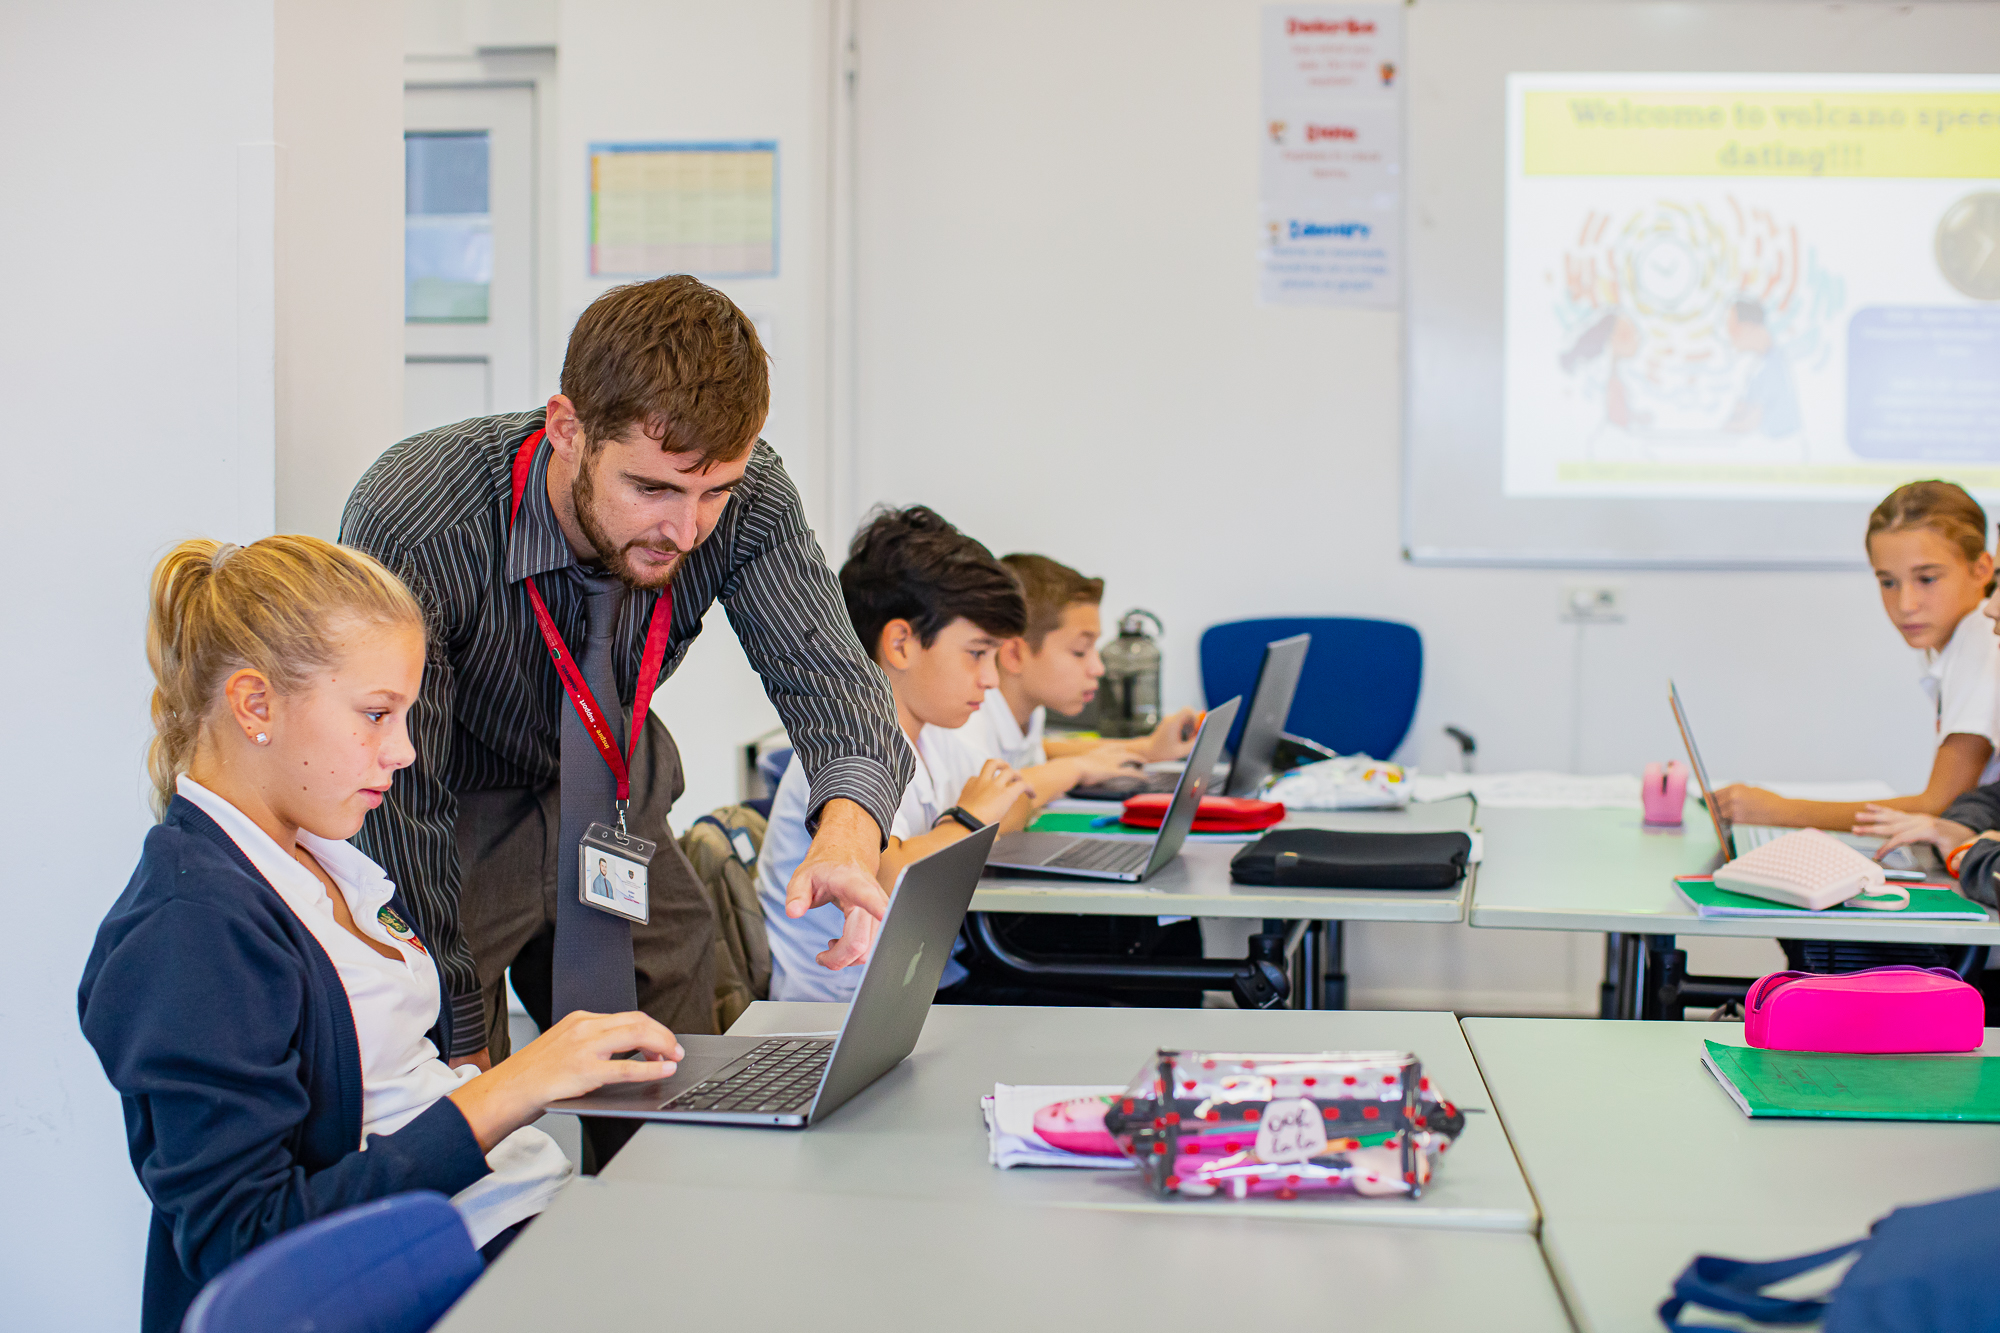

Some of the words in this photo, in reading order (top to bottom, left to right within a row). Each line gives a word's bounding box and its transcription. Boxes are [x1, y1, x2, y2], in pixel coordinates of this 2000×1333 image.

[1570, 98, 1725, 127] Welcome
[1734, 103, 1766, 126] to
[1774, 101, 1907, 127] volcano
[1919, 108, 2000, 134] spee
[1719, 140, 1864, 177] dating!!!
[561, 664, 579, 692] celebrate
[579, 699, 596, 723] support
[596, 729, 610, 749] inspire
